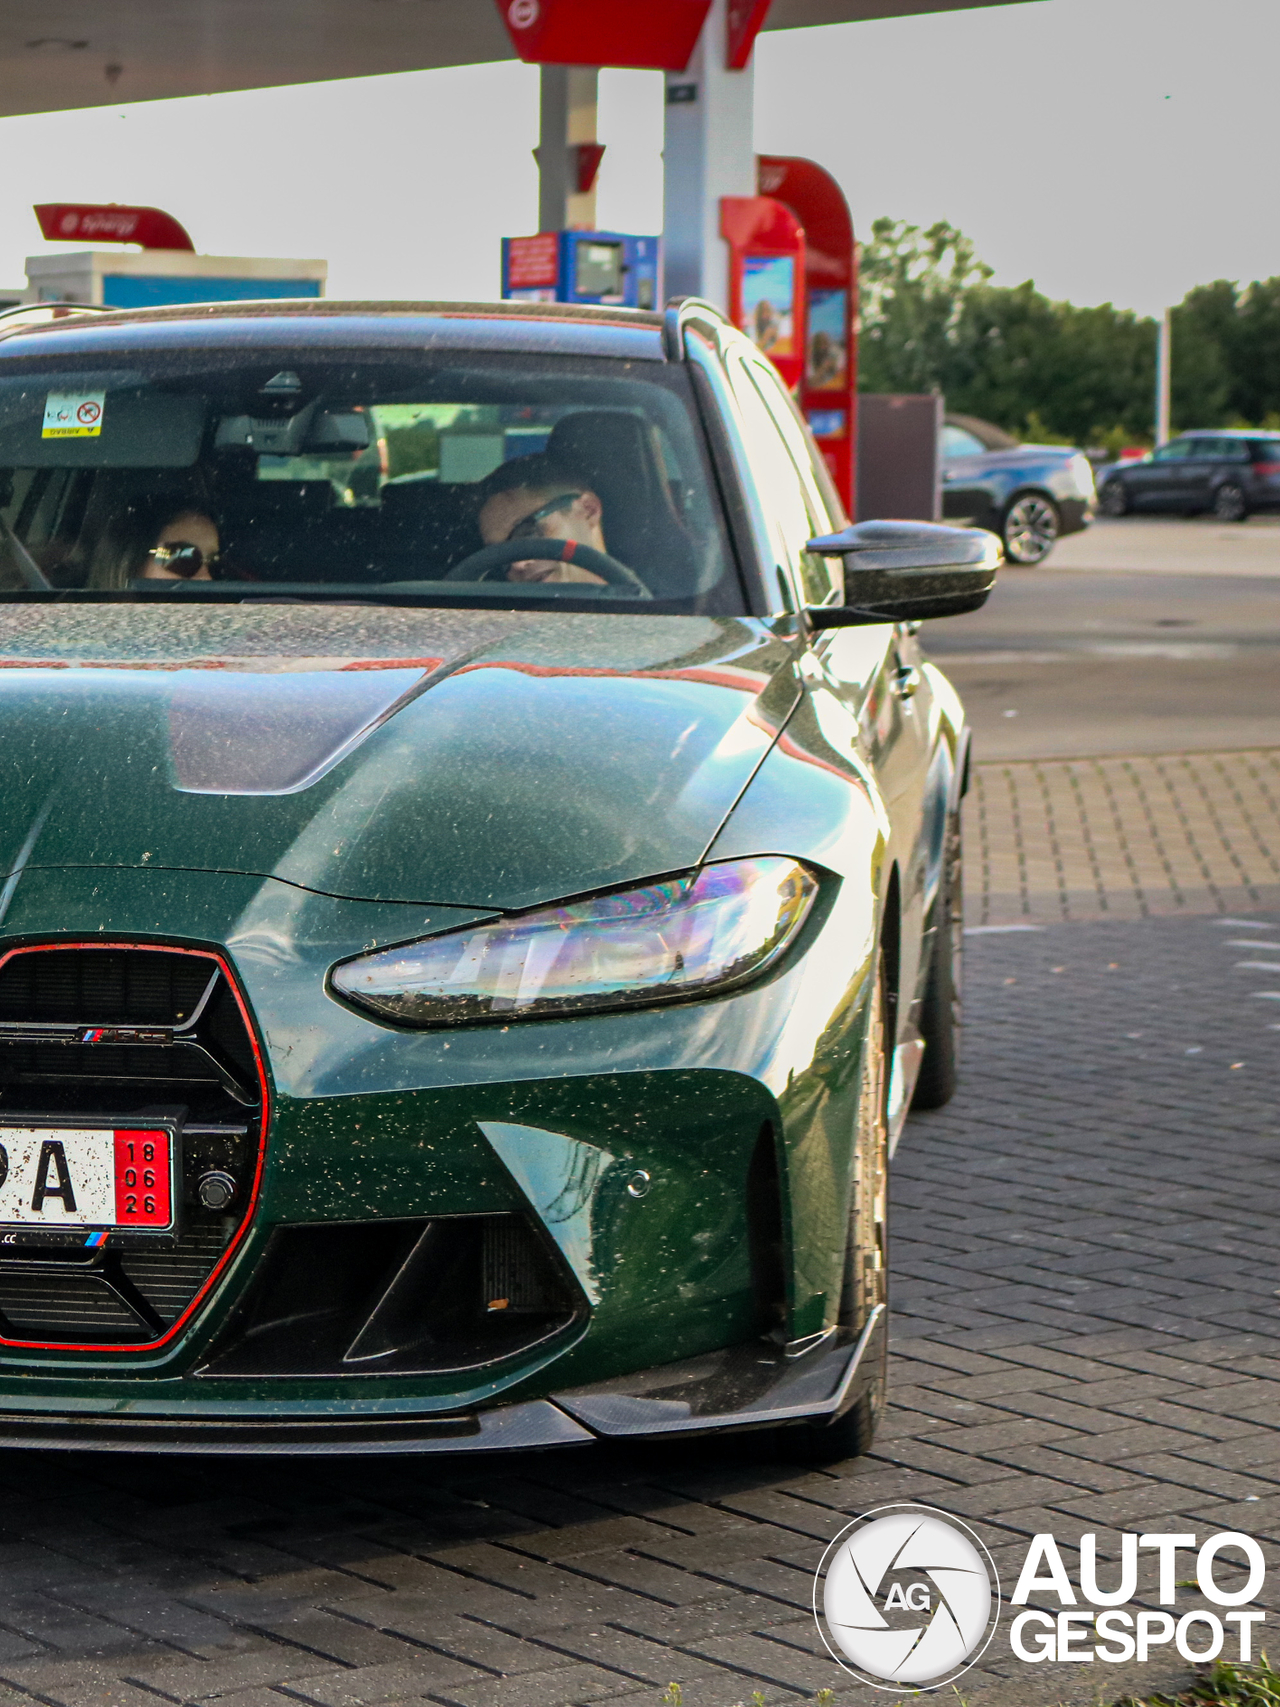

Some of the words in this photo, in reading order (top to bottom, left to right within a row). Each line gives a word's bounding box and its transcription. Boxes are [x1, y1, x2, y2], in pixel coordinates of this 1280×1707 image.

[126, 1142, 155, 1162] 18
[31, 1140, 78, 1213] A
[125, 1168, 155, 1188] 06
[125, 1194, 155, 1214] 26
